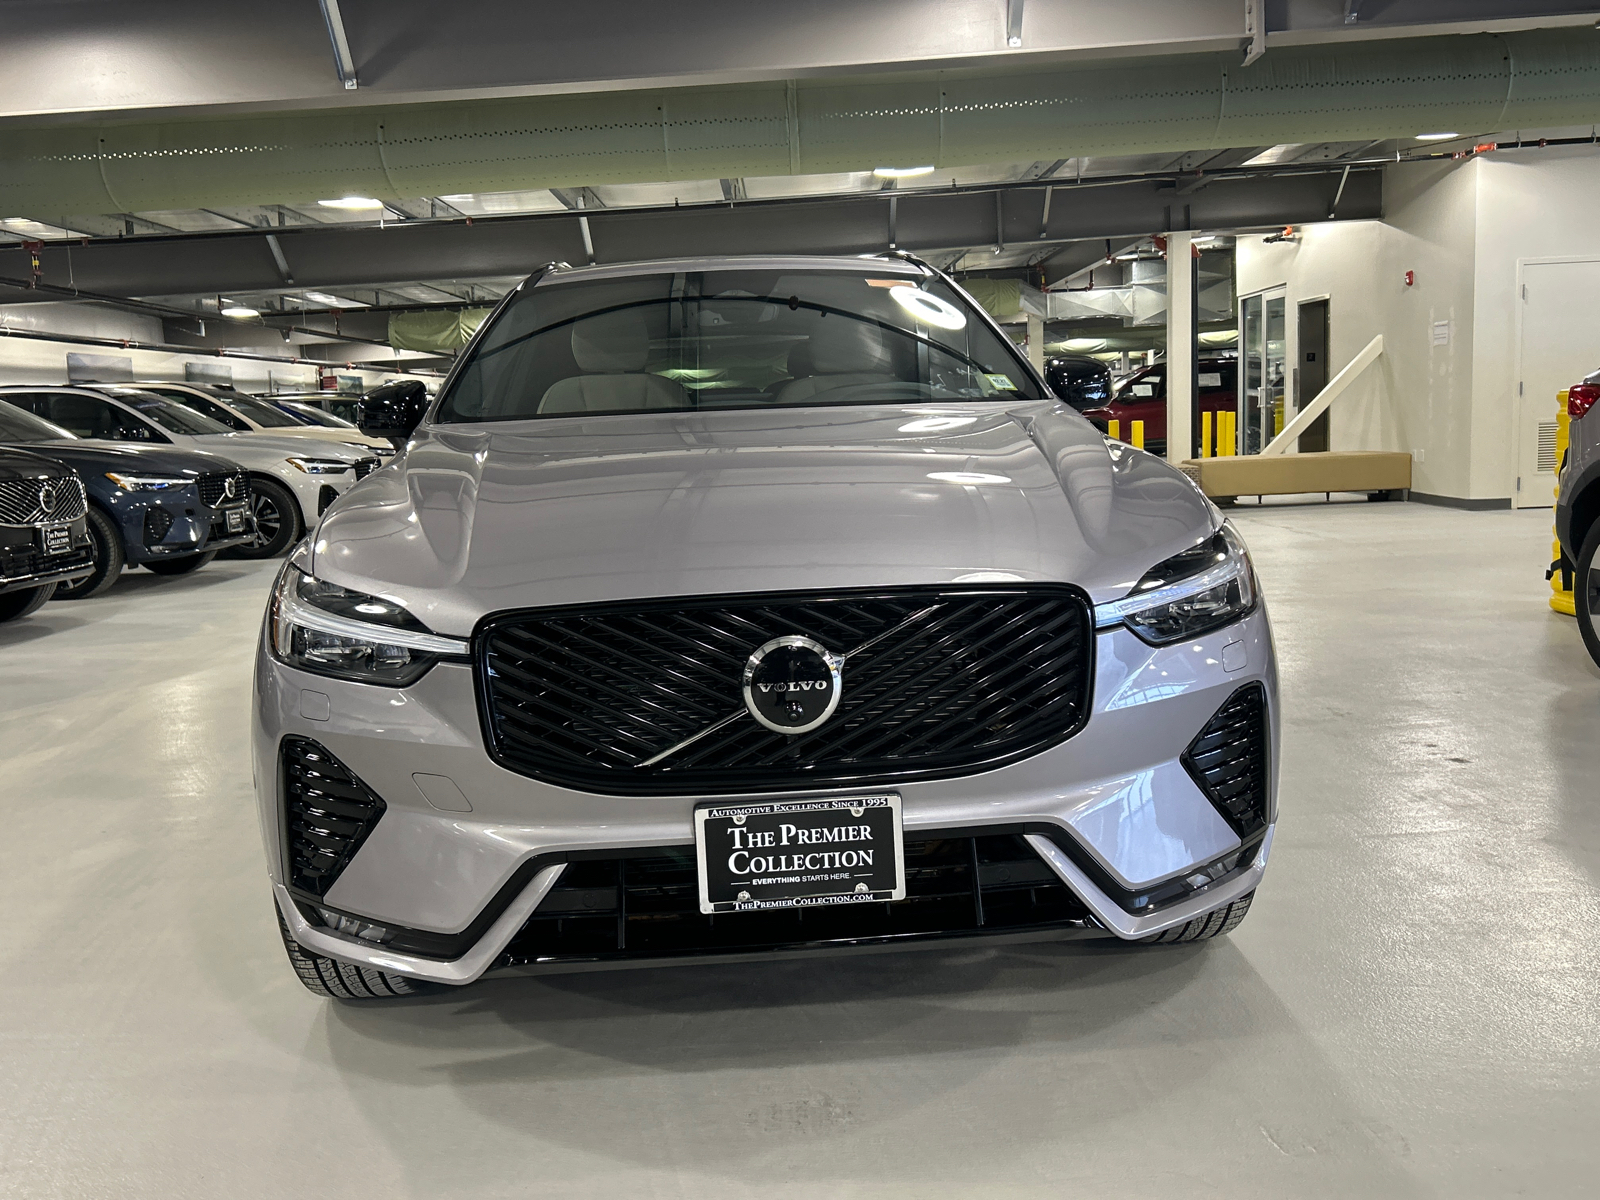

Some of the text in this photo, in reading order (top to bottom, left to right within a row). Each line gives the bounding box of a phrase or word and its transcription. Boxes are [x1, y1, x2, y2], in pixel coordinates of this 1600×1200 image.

[757, 680, 827, 693] VOLVO
[711, 798, 887, 817] AUTOMOTIVE EXCELLENCE SINCE 1995
[727, 824, 873, 849] THE PREMIER
[728, 850, 874, 874] COLLECTION
[752, 876, 800, 885] EVERYTHING
[802, 874, 829, 882] STARTS
